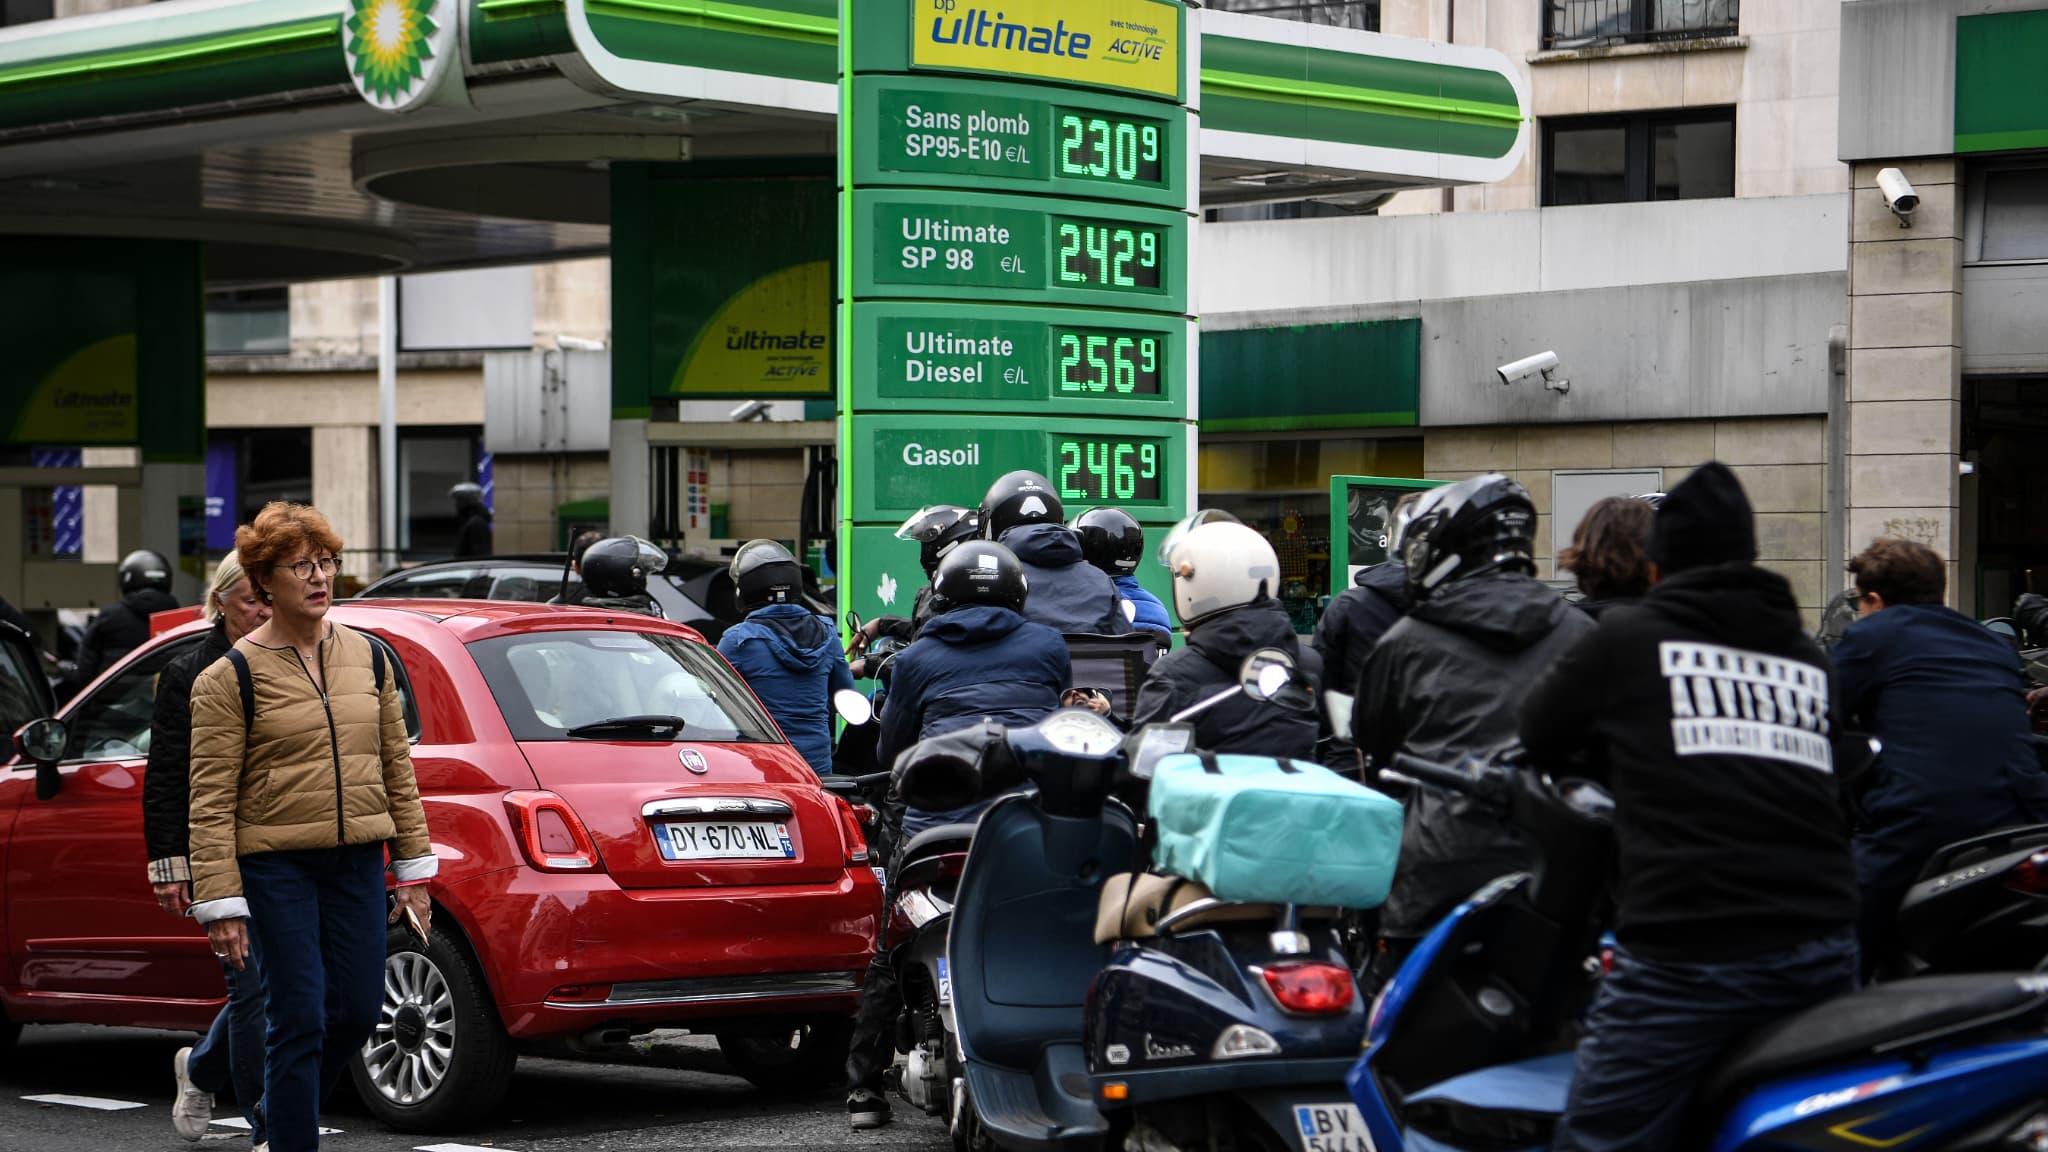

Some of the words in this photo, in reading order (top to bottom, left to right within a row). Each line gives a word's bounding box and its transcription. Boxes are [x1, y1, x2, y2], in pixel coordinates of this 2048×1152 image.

[931, 8, 1091, 60] ultimate
[1109, 19, 1125, 29] avec
[1107, 38, 1164, 61] ACTIVE
[905, 104, 961, 130] Sans
[967, 109, 1030, 136] plomb
[905, 133, 1002, 161] SP95-E10
[1005, 144, 1031, 164] €/L
[901, 217, 1010, 245] Ultimate
[901, 246, 937, 269] SP
[945, 248, 974, 271] 98
[999, 254, 1026, 274] €/L
[726, 330, 826, 350] ultimate
[905, 331, 1014, 356] Ultimate
[764, 365, 820, 377] ACTIVE
[905, 360, 983, 383] Diesel
[1003, 366, 1030, 385] €/L
[902, 443, 980, 466] Gasoil
[670, 825, 779, 851] DY-670-NL
[782, 840, 793, 852] 75
[1315, 1109, 1349, 1133] BV
